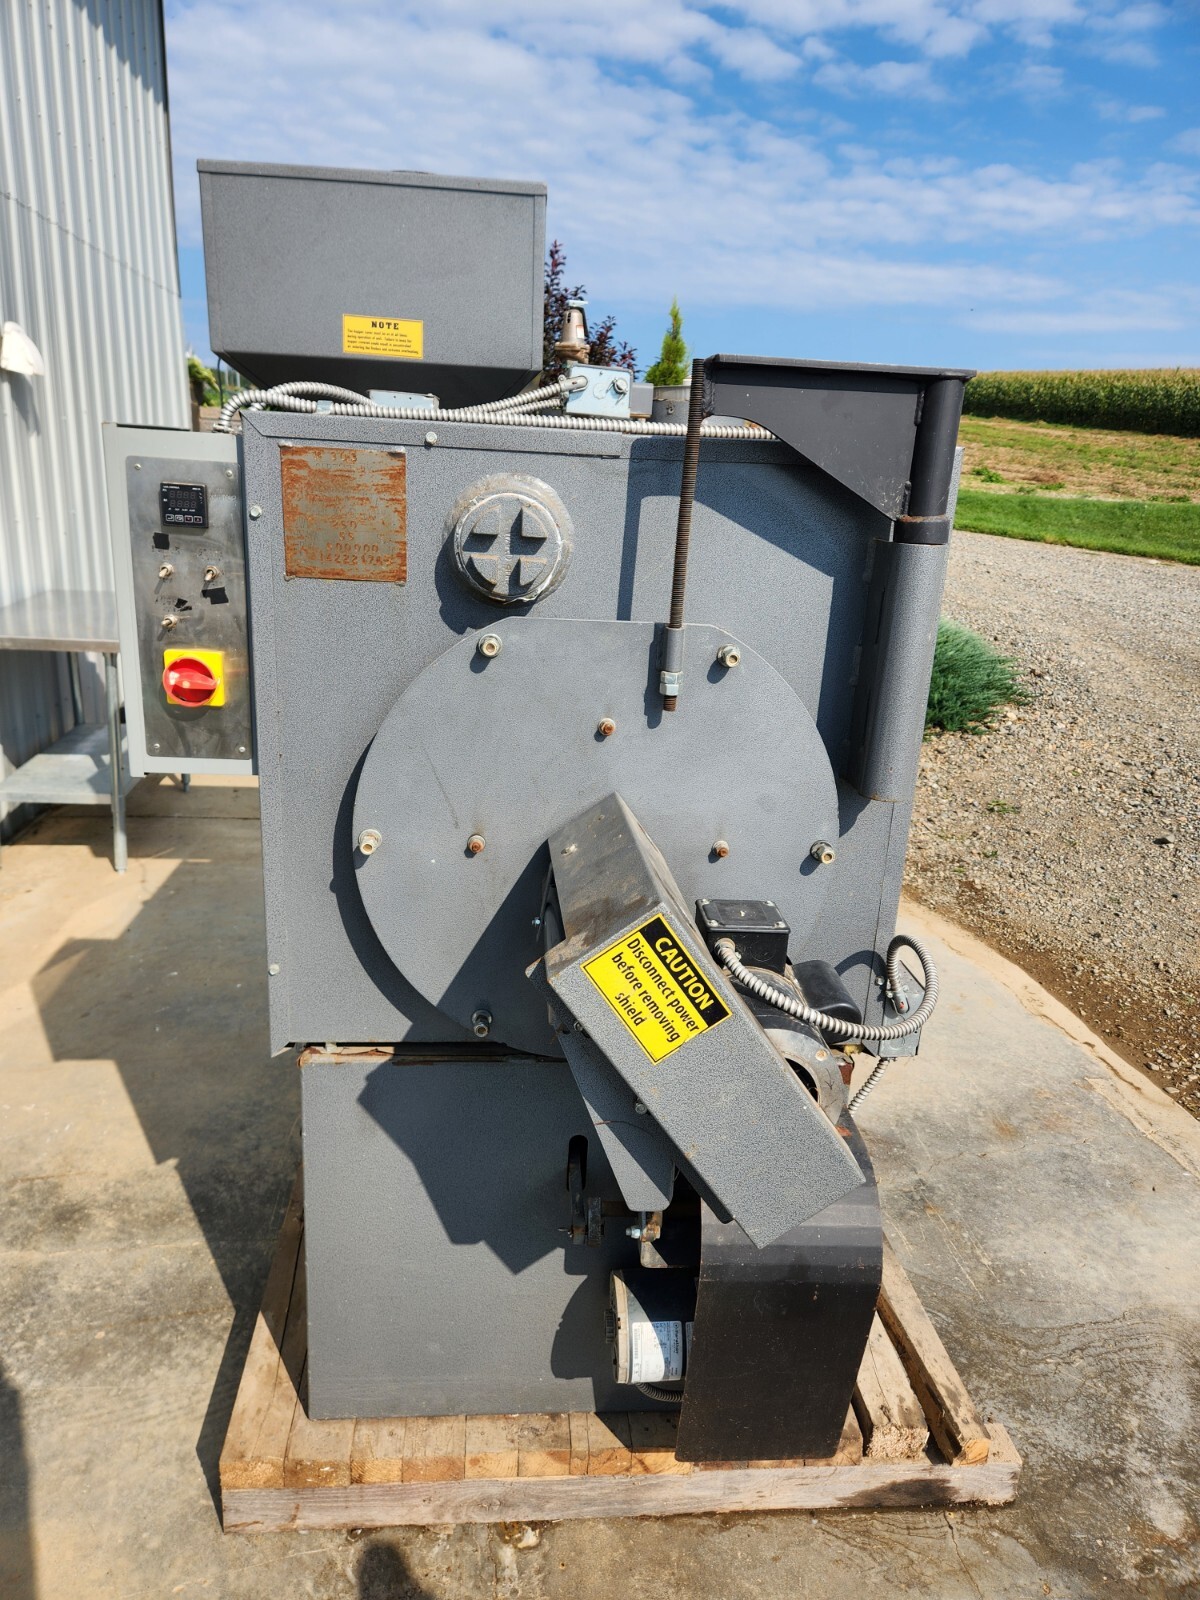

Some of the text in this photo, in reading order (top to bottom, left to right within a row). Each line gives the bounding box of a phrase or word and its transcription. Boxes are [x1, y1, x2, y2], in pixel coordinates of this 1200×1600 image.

[371, 320, 399, 330] NOTE
[611, 952, 681, 1043] before removing
[614, 992, 646, 1027] shield
[626, 938, 700, 1032] Disconnect power
[655, 937, 714, 1010] CAUTION
